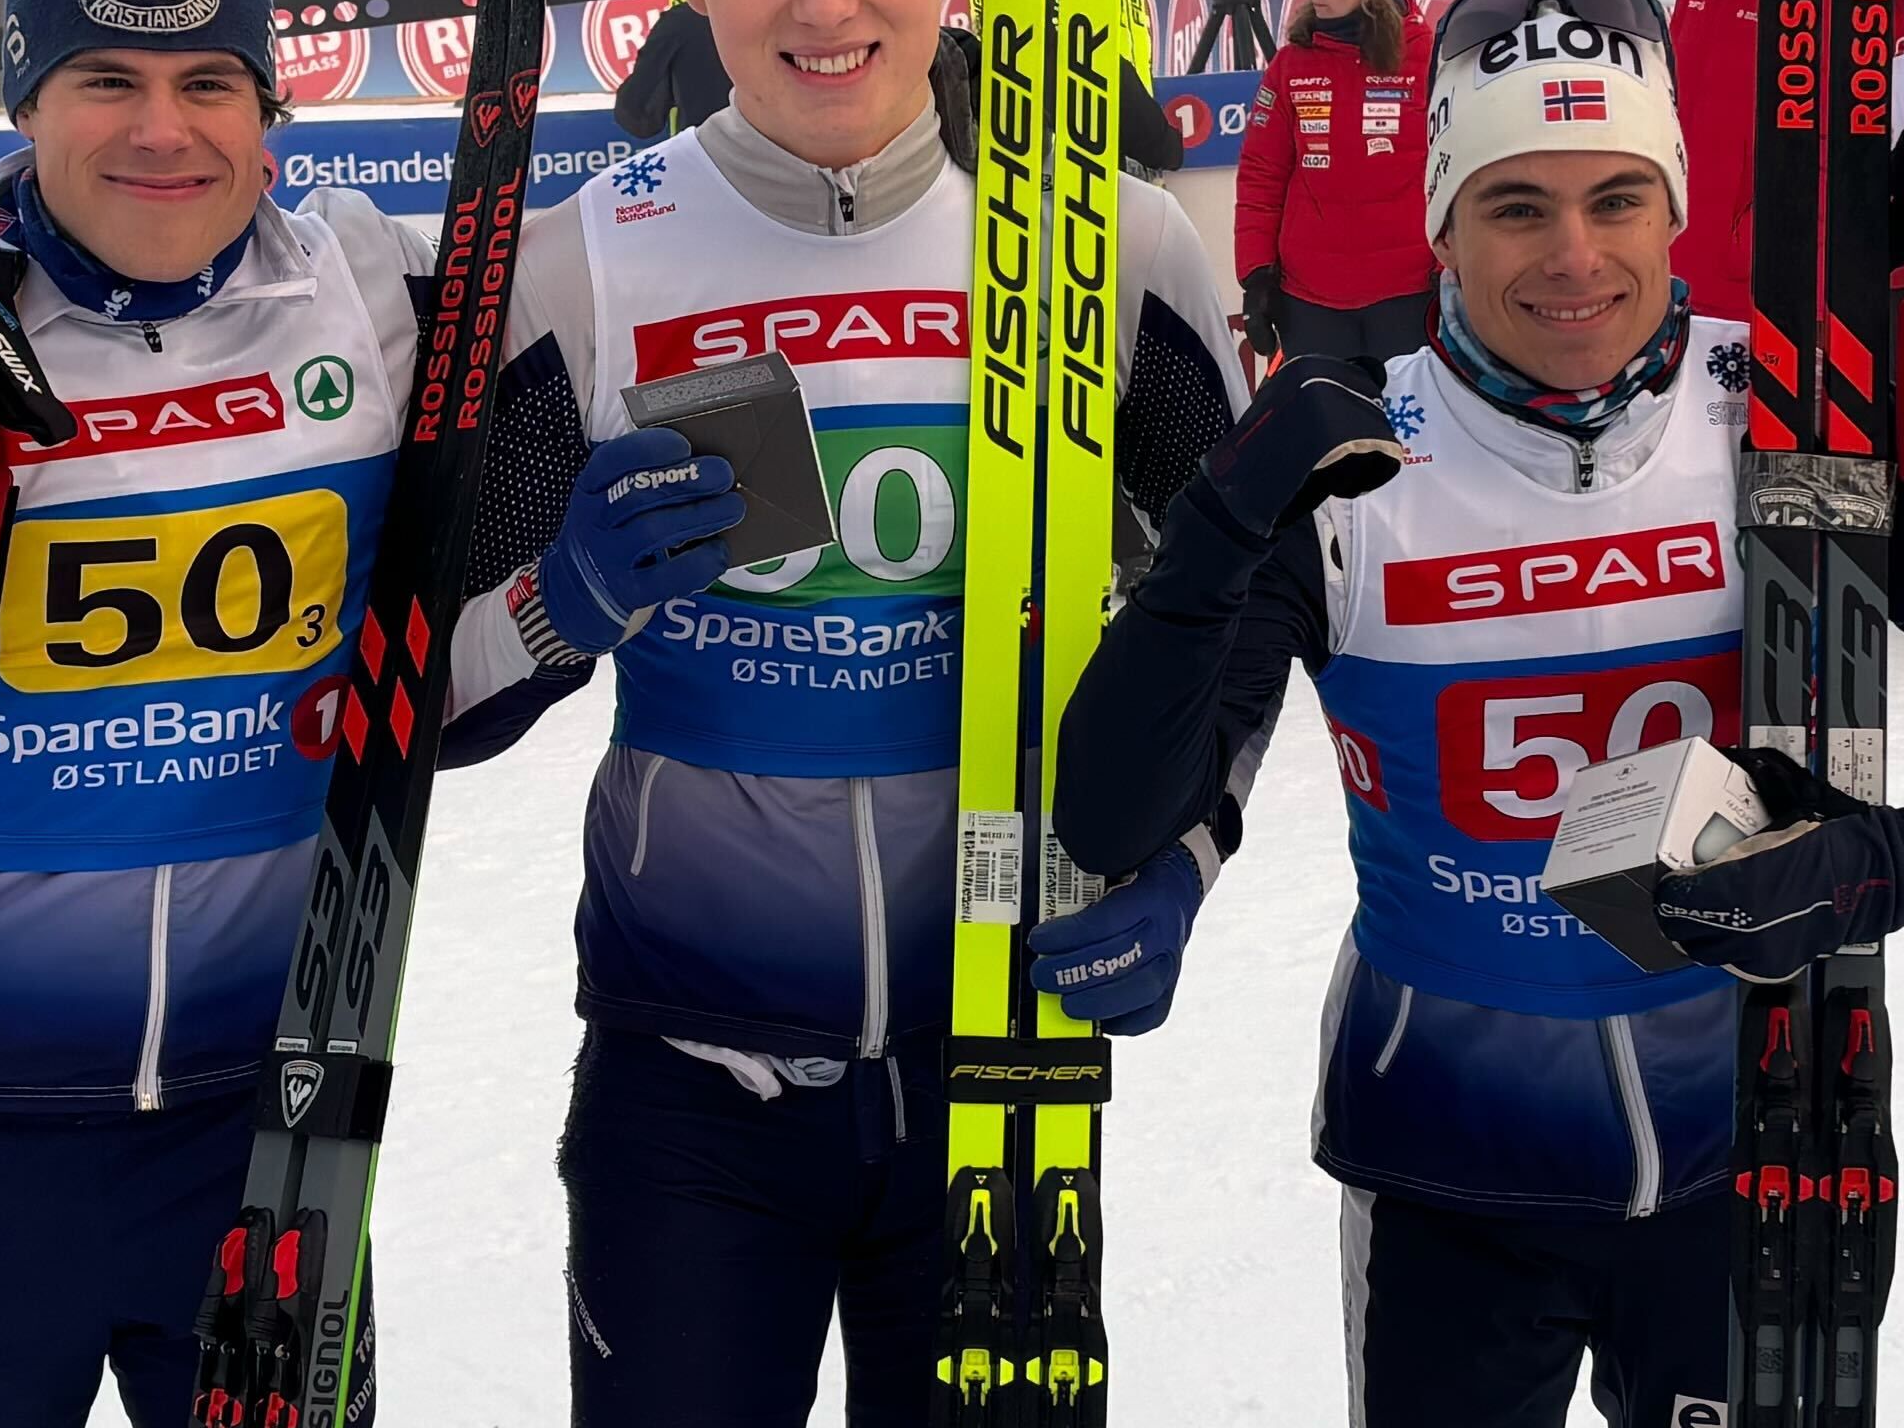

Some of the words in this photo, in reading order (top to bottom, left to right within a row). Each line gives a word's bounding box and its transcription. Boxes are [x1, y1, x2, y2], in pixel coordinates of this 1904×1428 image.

[284, 151, 454, 188] Østlandet
[616, 199, 654, 215] Norges
[616, 203, 676, 225] Skiforbund
[984, 13, 1035, 459] FISCHER
[1063, 13, 1110, 459] FISCHER
[414, 186, 483, 442] ROSSIGNOL
[457, 166, 523, 430] ROSSIGNOL
[692, 302, 961, 367] SPAR
[45, 522, 293, 668] 50
[296, 604, 326, 649] 3
[1447, 535, 1714, 610] SPAR
[661, 596, 957, 656] SpareBank
[731, 651, 956, 692] ØSTLANDET
[52, 743, 283, 790] ØSTLANDET
[1660, 903, 1731, 924] CRAFT
[949, 1064, 1103, 1081] FISCHER
